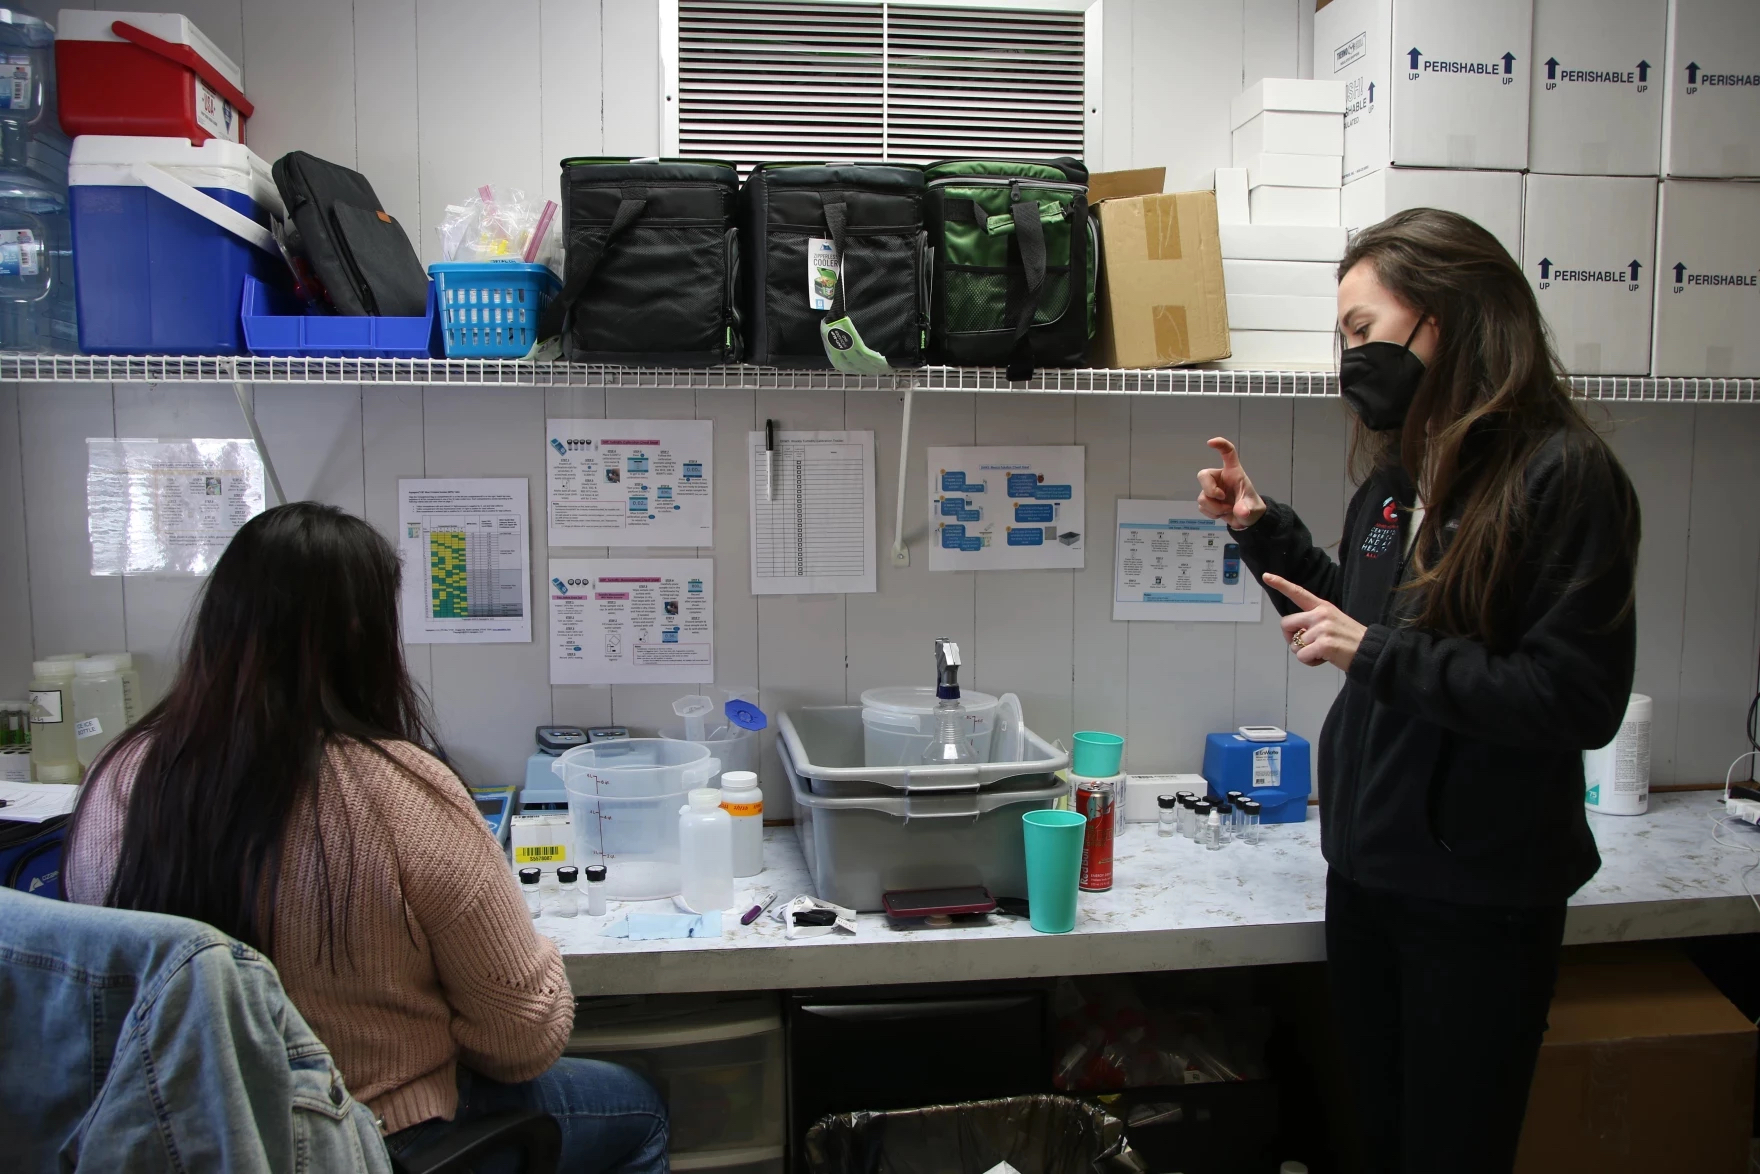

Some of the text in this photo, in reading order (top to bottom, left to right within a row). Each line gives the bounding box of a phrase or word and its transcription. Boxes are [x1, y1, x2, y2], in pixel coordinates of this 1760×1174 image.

[1424, 60, 1499, 75] PERISHABLE
[1408, 73, 1420, 81] UP
[1560, 70, 1634, 83] PERISHABLE
[1502, 77, 1513, 85] UP
[1545, 82, 1557, 91] UP
[1636, 85, 1648, 93] UP
[1686, 87, 1698, 95] UP
[1367, 104, 1375, 114] UP
[813, 259, 839, 267] COOLER
[1554, 270, 1626, 282] PERISHABLE
[1687, 274, 1757, 286] PERISHABLE
[1539, 282, 1550, 290] UP
[1628, 284, 1639, 292] UP
[1673, 286, 1684, 294] UP
[1080, 865, 1089, 885] Red
